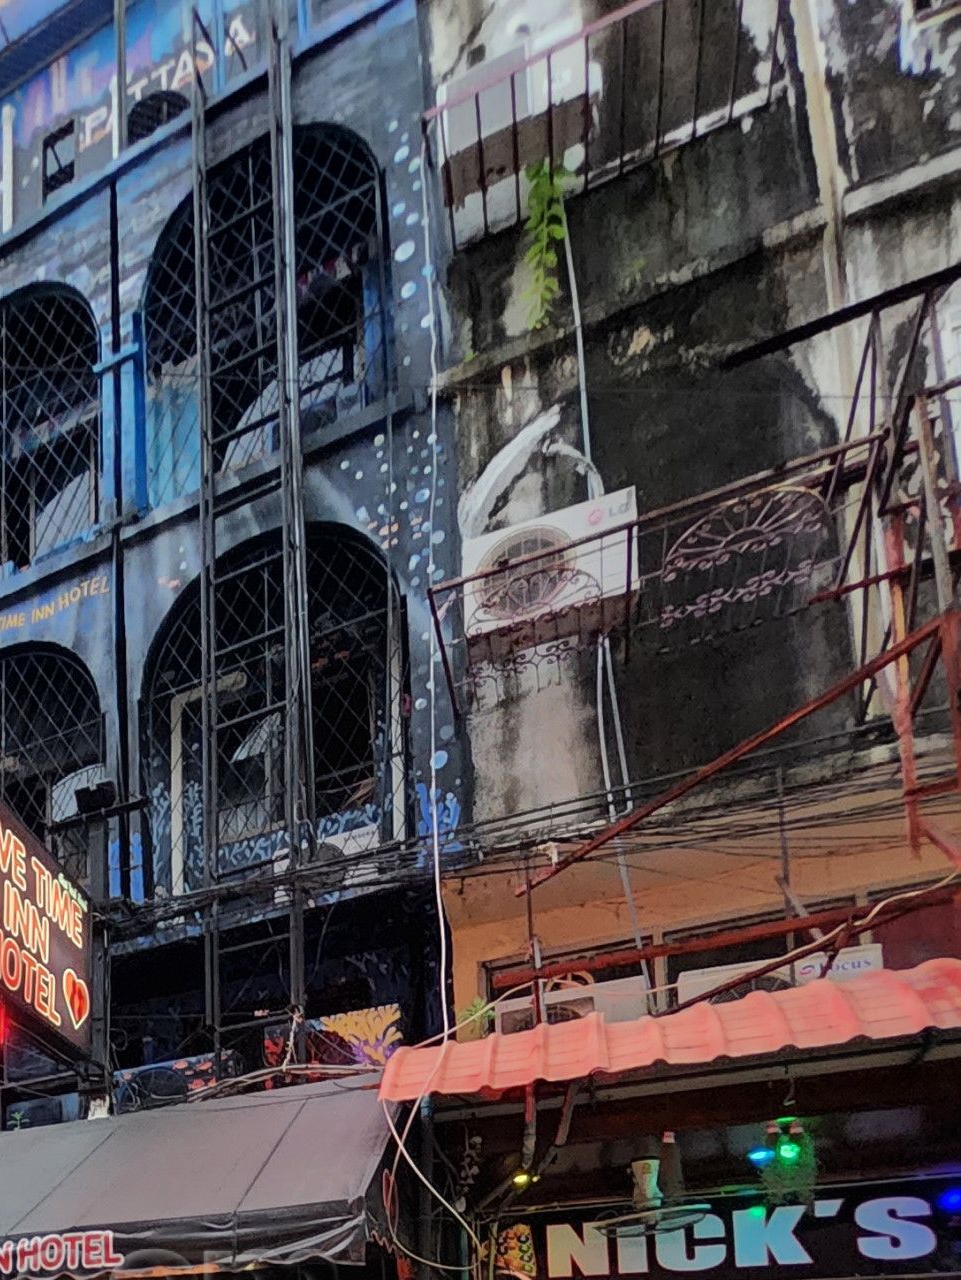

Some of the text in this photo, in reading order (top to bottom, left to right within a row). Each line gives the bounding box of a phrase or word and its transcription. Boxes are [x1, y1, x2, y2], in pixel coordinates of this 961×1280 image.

[31, 601, 55, 624] INN
[58, 575, 110, 611] HOTEL
[4, 880, 49, 964] INN
[31, 857, 83, 949] TIME
[16, 1231, 125, 1273] HOTEL
